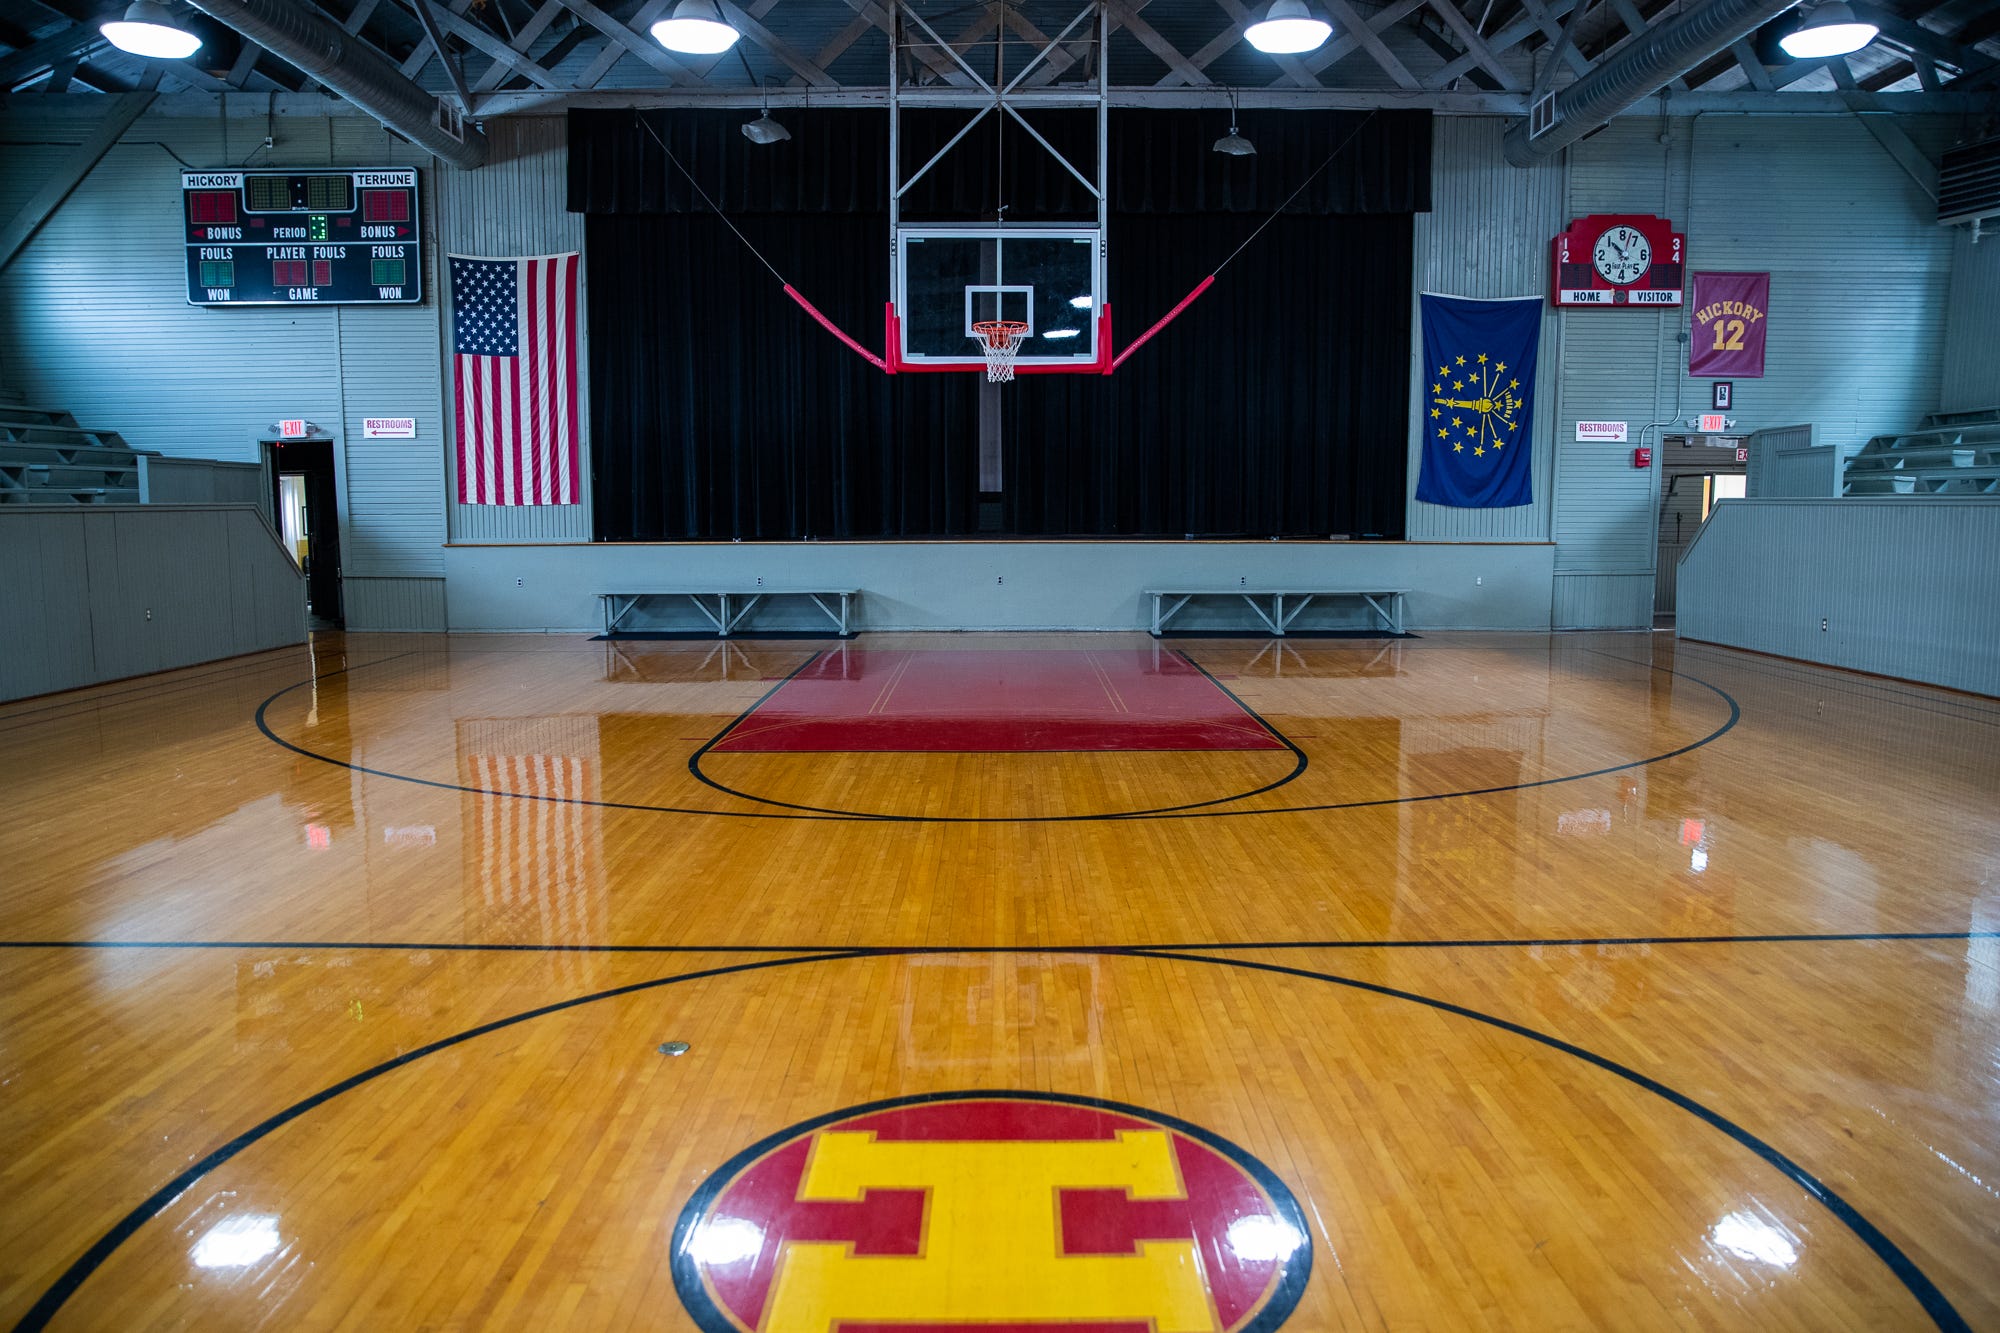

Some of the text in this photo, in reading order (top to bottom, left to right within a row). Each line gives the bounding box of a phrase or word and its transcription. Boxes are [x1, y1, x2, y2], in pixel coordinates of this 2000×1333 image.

[187, 175, 238, 186] HICKORY
[357, 174, 412, 185] TERHUNE
[207, 227, 242, 240] BONUS
[273, 227, 306, 238] PERIOD
[360, 225, 395, 238] BONUS
[1619, 230, 1626, 241] 8
[1607, 235, 1611, 247] 1
[1631, 235, 1639, 247] 7
[1672, 238, 1680, 250] 3
[200, 247, 233, 260] FOULS
[266, 246, 346, 259] PLAYER FOULS
[372, 246, 405, 258] FOULS
[1562, 251, 1570, 263] 2
[1598, 249, 1605, 261] 2
[1640, 249, 1647, 261] 6
[1672, 251, 1680, 263] 4
[1604, 263, 1611, 275] 3
[1617, 269, 1625, 280] 4
[1632, 263, 1639, 275] 5
[208, 288, 231, 301] WON
[289, 287, 318, 300] GAME
[379, 286, 402, 299] WON
[1573, 292, 1600, 302] HOME
[1637, 292, 1673, 302] VISITOR
[1695, 300, 1764, 325] HICKORY
[1712, 319, 1745, 351] 12
[1503, 391, 1513, 419] INDIANA
[284, 421, 302, 435] EXIT
[366, 419, 412, 429] RESTROOMS
[1579, 423, 1625, 433] RESTROOMS
[1703, 415, 1722, 430] EXIT
[1737, 449, 1747, 461] EX
[760, 1130, 1220, 1333] H
